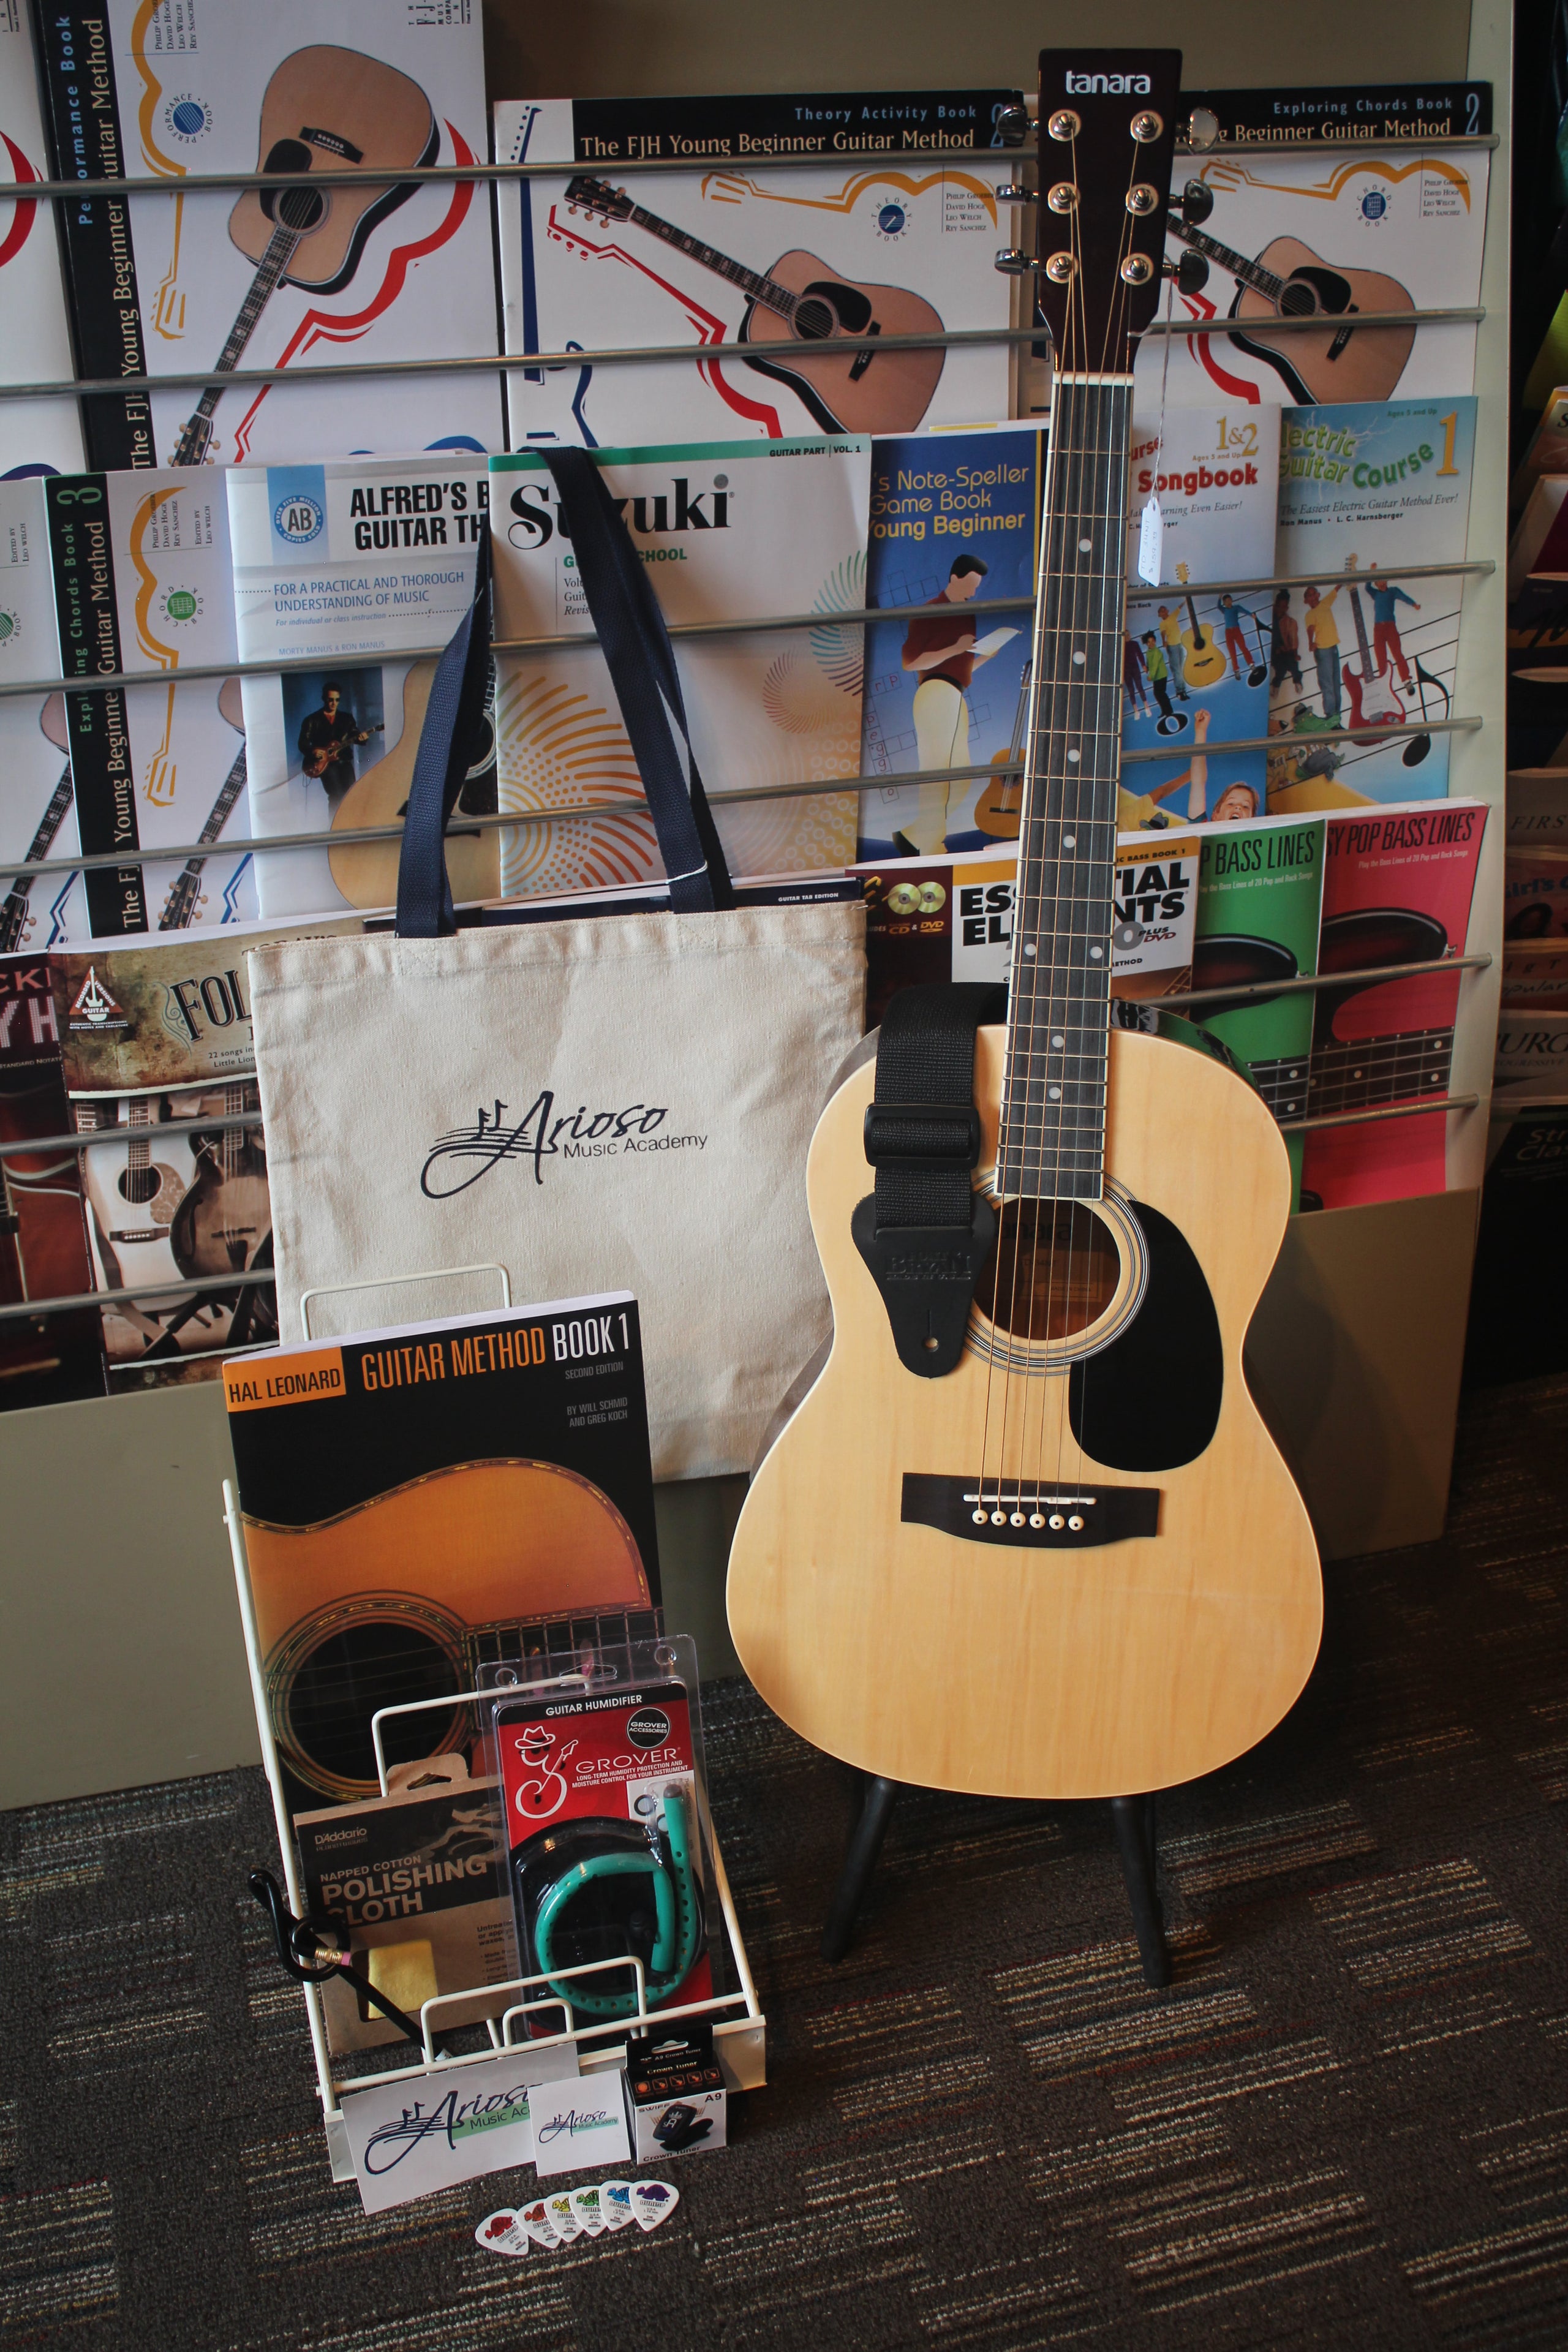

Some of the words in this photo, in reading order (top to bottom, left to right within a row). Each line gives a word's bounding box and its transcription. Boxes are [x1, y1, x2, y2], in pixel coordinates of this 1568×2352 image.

[56, 16, 76, 71] Book
[82, 19, 111, 110] Method
[1066, 70, 1151, 94] tanara
[795, 107, 851, 123] Theory
[862, 105, 927, 121] Activity
[938, 106, 976, 119] Book
[1274, 100, 1348, 116] Exploring
[1357, 98, 1408, 112] Chords
[1417, 98, 1452, 110] Book
[1465, 93, 1480, 135] 2
[1235, 123, 1315, 141] Beginner
[1322, 121, 1377, 139] Guitar
[1384, 118, 1450, 137] Method
[67, 86, 93, 224] Peormance
[581, 137, 619, 157] The
[627, 135, 661, 160] FJH
[668, 134, 730, 157] Young
[738, 132, 826, 156] Beginner
[834, 131, 895, 151] Guitar
[903, 128, 974, 149] Method
[107, 201, 134, 301] Beginner
[121, 309, 140, 377] Young
[131, 429, 150, 470] The
[769, 448, 801, 458] GUITAR
[804, 446, 826, 456] PART
[834, 445, 852, 454] VOL.
[1436, 411, 1459, 475] 1
[898, 464, 1030, 491] Note-Speller
[1352, 443, 1434, 488] Course
[1138, 462, 1258, 496] Songbook
[56, 487, 102, 505] 3
[350, 482, 467, 518] ALFRED'S
[870, 495, 933, 515] Game
[940, 488, 992, 510] Book
[1191, 504, 1211, 513] Even
[1215, 501, 1242, 511] Easier!
[1280, 505, 1297, 515] The
[1300, 503, 1330, 514] Easiest
[1333, 500, 1366, 512] Electric
[1368, 498, 1398, 510] Guitar
[1400, 495, 1433, 507] Method
[1435, 492, 1458, 505] Ever!
[288, 508, 312, 532] AB
[933, 513, 1026, 537] Beginner
[1357, 512, 1404, 522] Harnsberger
[61, 523, 77, 567] Book
[354, 517, 448, 551] GUITAR
[84, 521, 109, 601] Method
[274, 583, 296, 595] FOR
[300, 582, 307, 594] A
[311, 579, 369, 594] PRACTICAL
[374, 576, 398, 589] AND
[401, 571, 464, 587] THOROUGH
[67, 578, 83, 638] Chords
[275, 595, 372, 612] UNDERSTANDING
[375, 593, 390, 605] OF
[394, 590, 429, 604] MUSIC
[288, 616, 323, 625] individual
[352, 612, 386, 621] instruction
[97, 609, 116, 674] Guitar
[75, 647, 92, 733] Expling
[105, 687, 128, 772] Beginne
[115, 777, 132, 843] Young
[1348, 823, 1381, 855] POP
[1382, 817, 1427, 851] BASS
[1428, 812, 1475, 845] LINES
[1152, 850, 1178, 858] BOOK
[1215, 839, 1262, 875] BASS
[1267, 831, 1315, 869] LINES
[124, 890, 141, 929] The
[889, 926, 910, 935] CD
[920, 921, 944, 929] DVD
[1139, 926, 1170, 937] PLUS
[1144, 932, 1177, 943] DVD
[75, 980, 91, 1009] RECORDED
[94, 980, 116, 1007] VERSIONS
[170, 970, 252, 1042] FOL
[214, 1059, 236, 1068] Little
[221, 1049, 243, 1058] songs
[420, 1090, 668, 1199] Arioso
[564, 1142, 617, 1158] Music
[623, 1134, 708, 1153] Academy
[361, 1342, 446, 1391] GUITAR
[451, 1327, 546, 1378] METHOD
[552, 1315, 614, 1361] BOOK
[618, 1313, 630, 1350] 1
[565, 1364, 594, 1380] SECOND
[595, 1361, 624, 1376] EDITION
[228, 1376, 263, 1403] HAL
[266, 1368, 342, 1398] LEONARD
[567, 1406, 576, 1416] BY
[577, 1401, 597, 1414] WILL
[598, 1396, 628, 1411] SCHMID
[569, 1415, 586, 1428] AND
[587, 1412, 606, 1425] GREG
[607, 1409, 628, 1422] KOCH
[545, 1703, 582, 1716] GUITAR
[586, 1695, 643, 1711] HUMIDIFIER
[576, 1748, 677, 1773] GROVER
[576, 1771, 608, 1782] LONG-TERM
[609, 1768, 636, 1776] HUMIDITY
[637, 1763, 669, 1772] PROTECTION
[571, 1779, 600, 1789] MOISTURE
[601, 1776, 626, 1785] CONTROL
[653, 1765, 688, 1776] INSTRUMENT
[315, 1826, 367, 1845] D'Addario
[320, 1866, 369, 1882] NAPPED
[373, 1855, 421, 1871] COTTON
[322, 1855, 488, 1905] POLISHING
[647, 2065, 673, 2075] Crown
[638, 2103, 671, 2113] SWIFF
[705, 2092, 722, 2103] A9
[470, 2111, 507, 2130] Music
[539, 2109, 607, 2143] Arioso
[594, 2119, 617, 2128] Academy
[643, 2152, 673, 2162] Crown
[676, 2146, 701, 2155] Tuner
